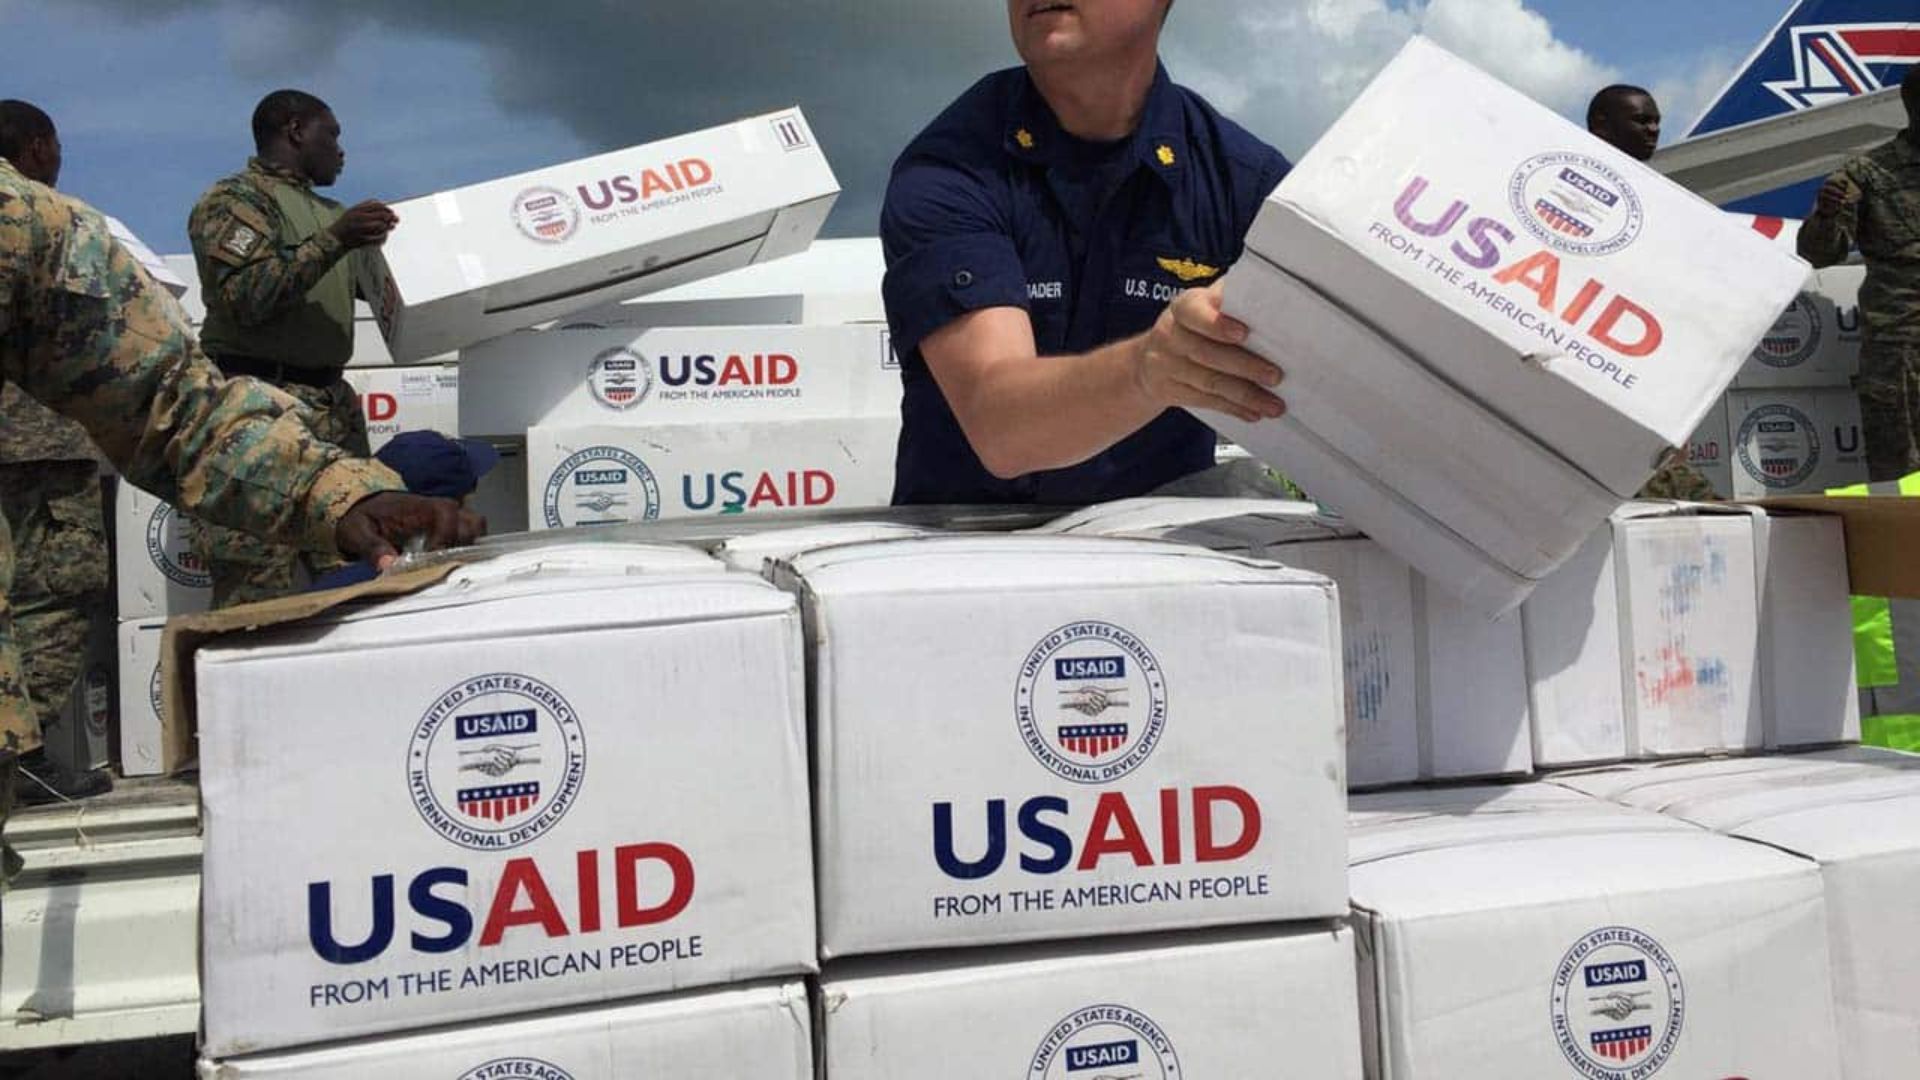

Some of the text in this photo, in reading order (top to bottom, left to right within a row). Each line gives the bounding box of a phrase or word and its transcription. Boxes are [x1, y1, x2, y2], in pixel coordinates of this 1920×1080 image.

[577, 158, 712, 210] USAID
[1565, 172, 1611, 202] USAID
[1125, 278, 1150, 298] U.S.
[1393, 176, 1663, 358] USAID
[1368, 222, 1639, 390] FROM THE AMERICAN PEOPLE
[660, 354, 797, 386] USAID
[660, 387, 801, 400] FROM THE AMERICAN PEOPLE
[579, 471, 623, 483] USAID
[683, 470, 835, 510] USAID
[1024, 624, 1156, 678] UNITED STATES AGENCY
[1061, 660, 1118, 677] USAID
[418, 676, 574, 740] UNITED STATES AGENCY
[462, 714, 529, 735] USAID
[1020, 699, 1163, 780] INTERNATIONAL DEVELOPMENT
[412, 752, 582, 847] INTERNATIONAL DEVELOPMENT
[933, 785, 1262, 880] USAID
[308, 841, 696, 965] USAID
[934, 875, 1269, 918] FROM THE AMERICAN PEOPLE
[310, 935, 703, 1008] FROM THE AMERICAN PEOPLE
[1557, 930, 1674, 987] UNITED STATES AGENCY
[1590, 965, 1641, 983] USAID
[1033, 1008, 1170, 1072] UNITED STATES AGENCY
[1072, 1045, 1130, 1066] USAID
[1555, 1000, 1681, 1080] INTERNATIONAL DEVELOPMENT
[475, 1062, 532, 1080] STATES
